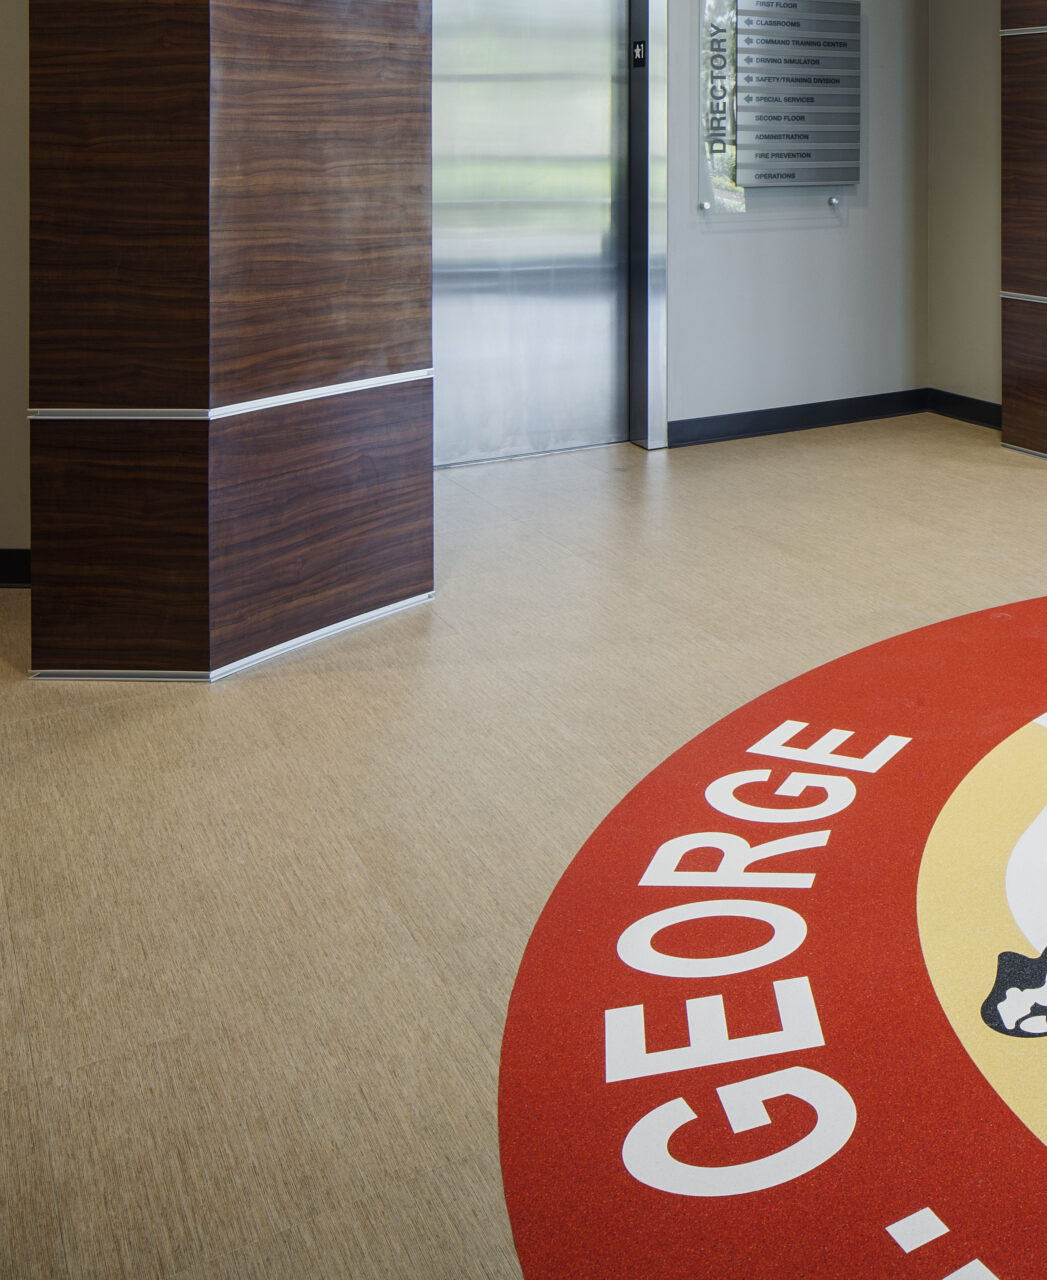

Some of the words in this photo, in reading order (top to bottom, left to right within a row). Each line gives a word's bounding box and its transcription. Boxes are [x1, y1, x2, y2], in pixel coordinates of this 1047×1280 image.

[755, 20, 800, 28] CLASSROOMS
[755, 57, 782, 65] DRIVING
[783, 58, 820, 66] SIMULATOR
[755, 76, 812, 84] SAFETY/TRAINING
[710, 23, 727, 154] DIRECTORY
[754, 133, 809, 141] ADMINISTRATION
[754, 172, 796, 180] OPERATIONS
[604, 719, 913, 1197] GEORGE
